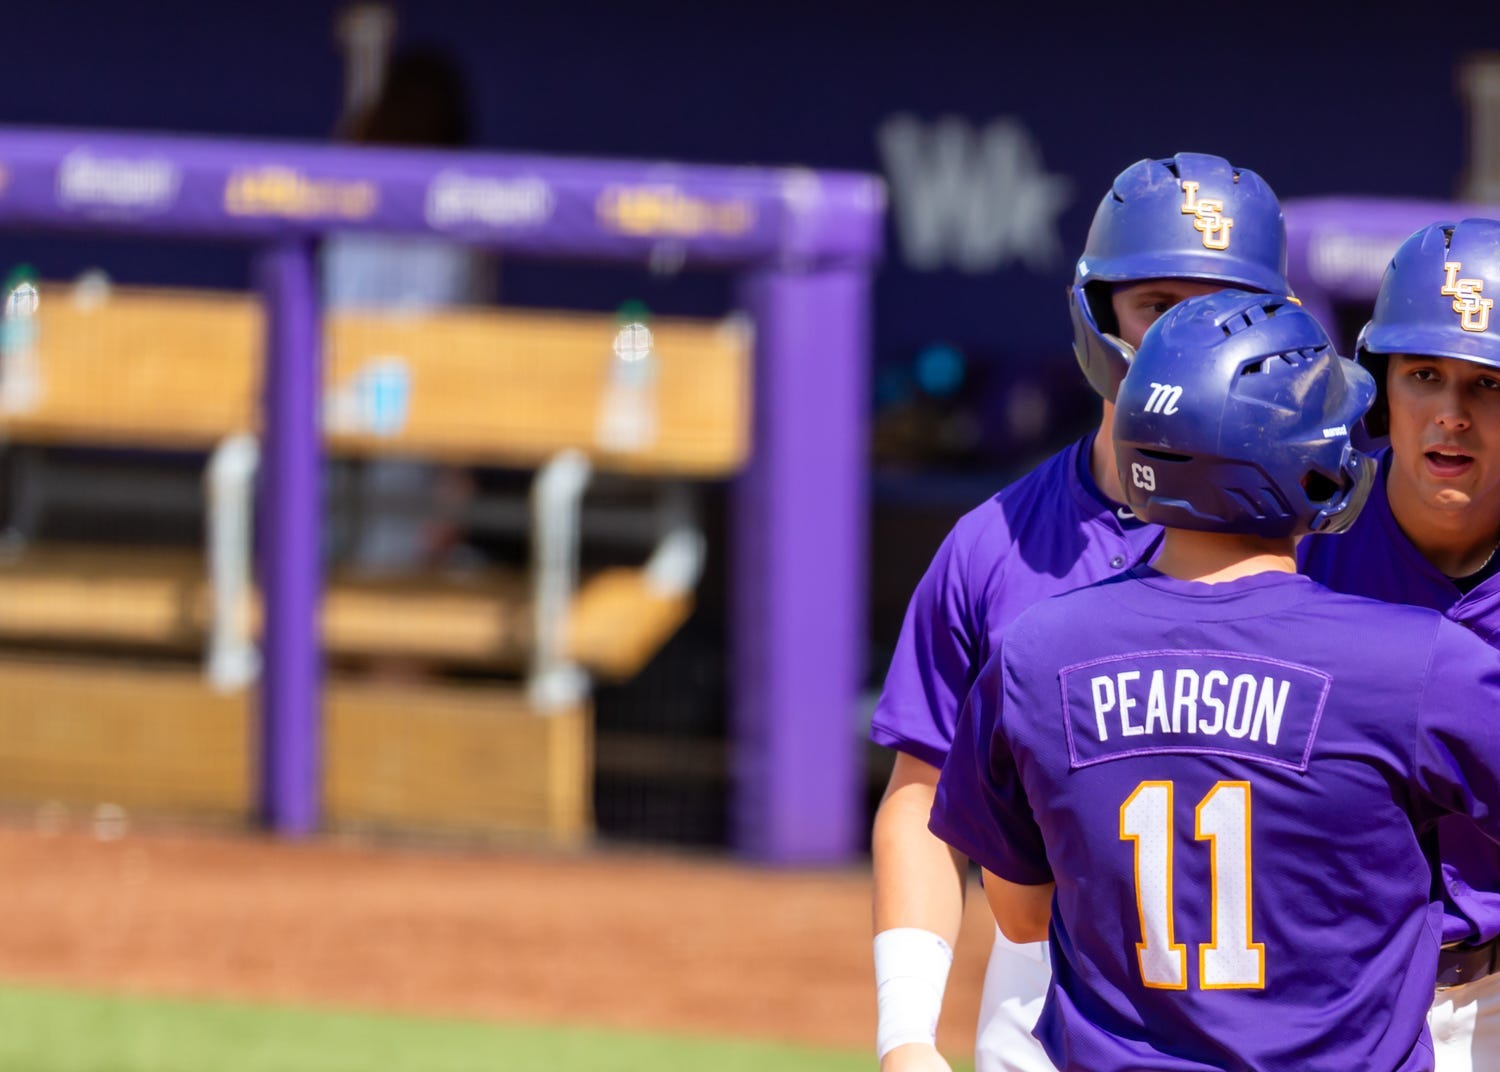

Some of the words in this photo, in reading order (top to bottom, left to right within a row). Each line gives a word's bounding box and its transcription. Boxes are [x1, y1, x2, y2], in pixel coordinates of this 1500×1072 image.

[1181, 180, 1233, 250] LSU
[1441, 261, 1493, 332] LSU
[1091, 668, 1290, 745] PEARSON
[1119, 780, 1265, 990] 11
